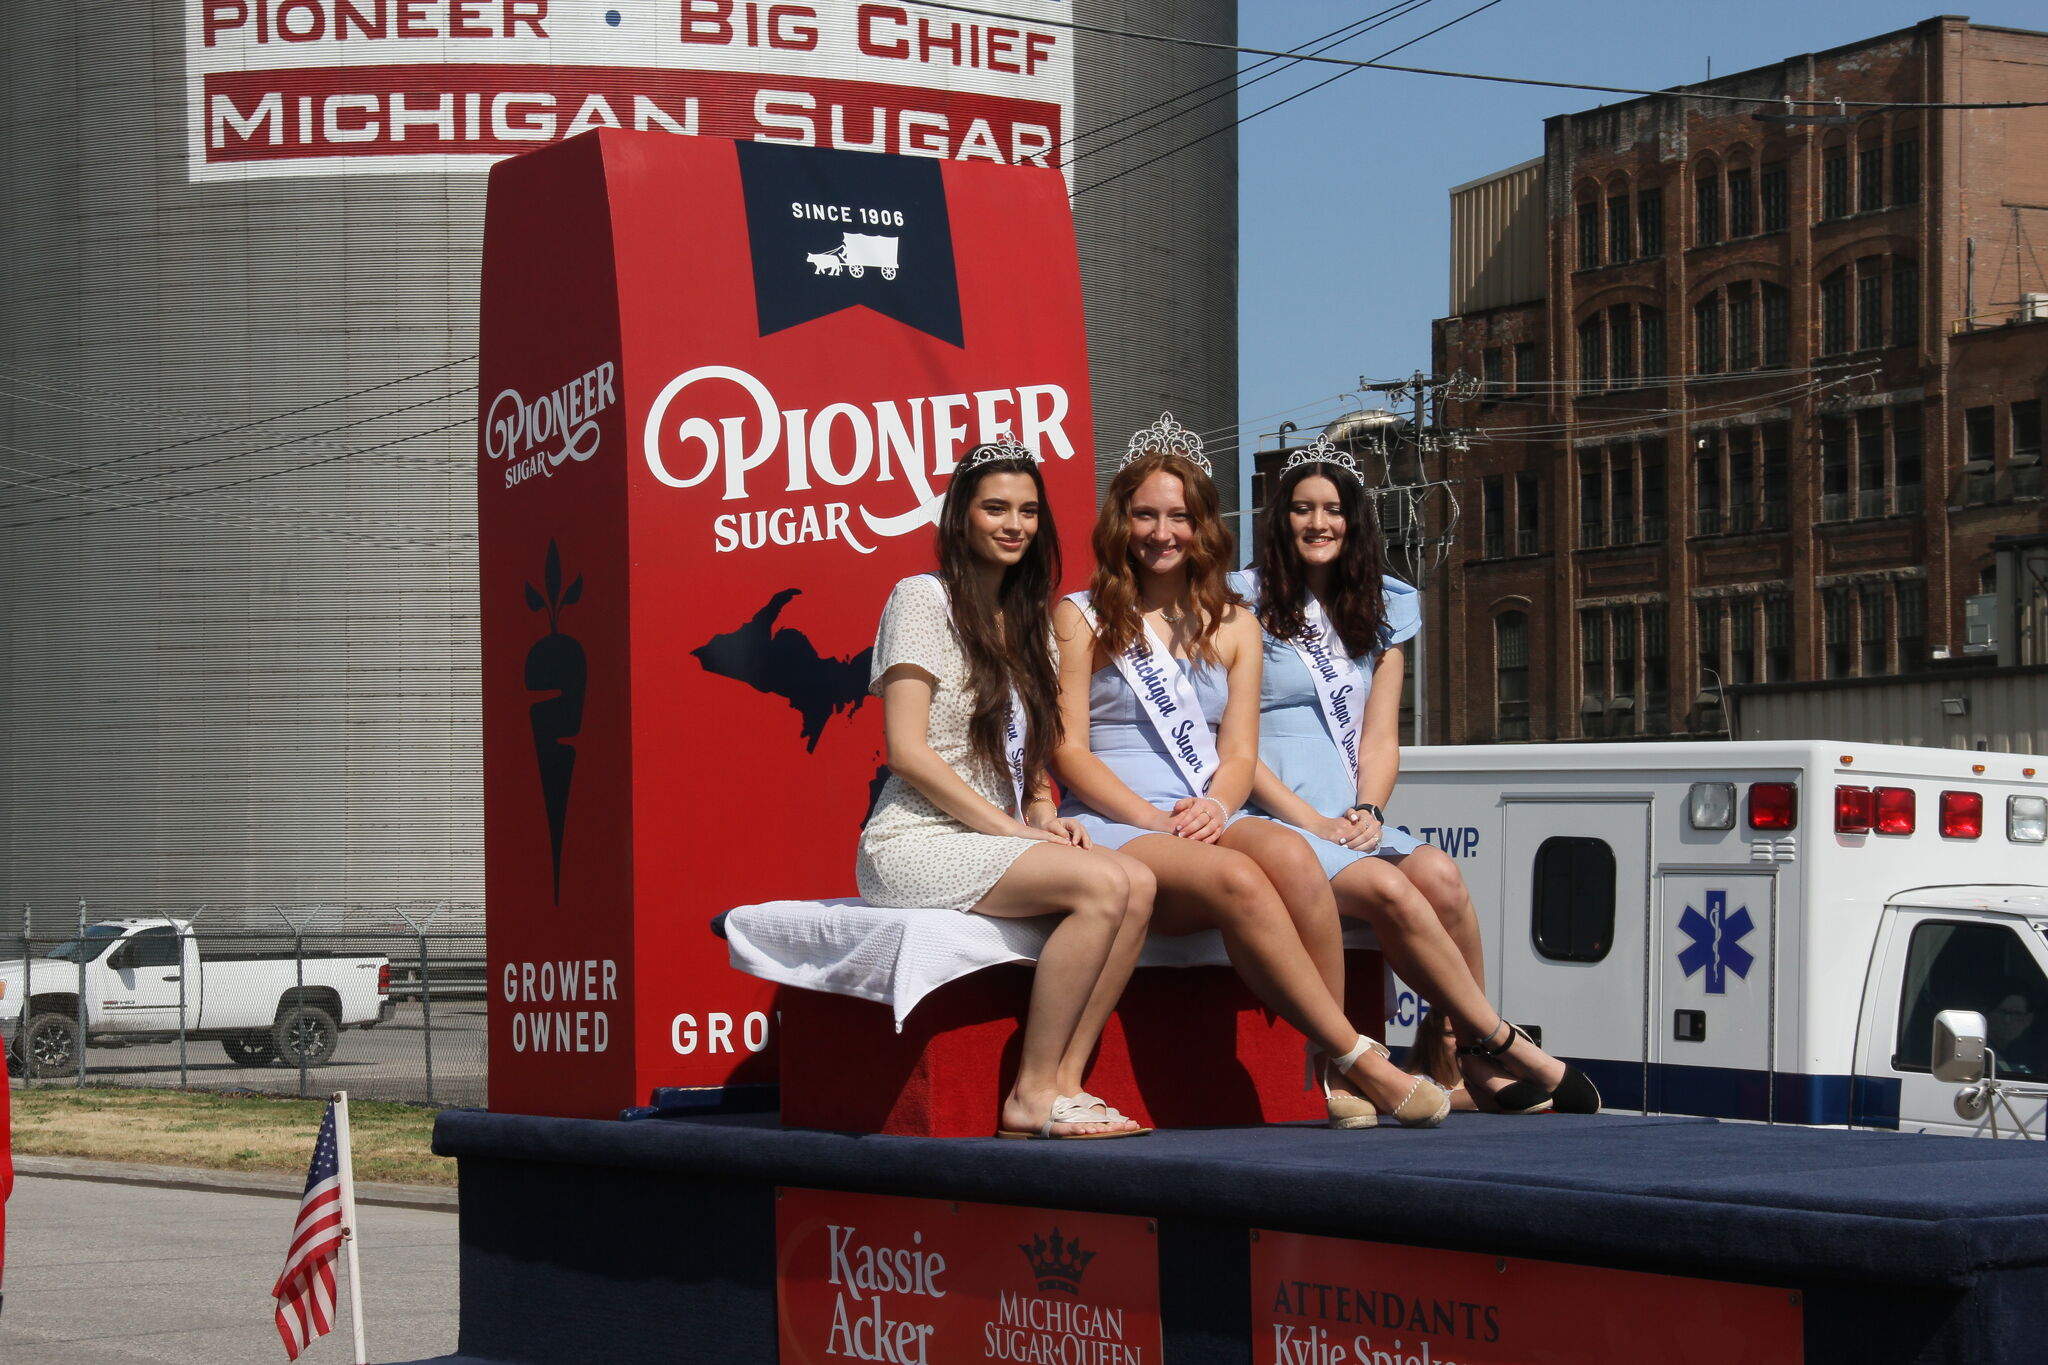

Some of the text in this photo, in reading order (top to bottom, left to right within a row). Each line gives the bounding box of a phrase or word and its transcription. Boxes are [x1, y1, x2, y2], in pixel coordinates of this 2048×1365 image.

[203, 0, 1056, 75] PIONEER BIG CHIEF
[211, 89, 1052, 168] MICHIGAN SUGAR
[792, 202, 904, 227] SINCE 1906
[485, 361, 616, 466] PIONEER
[505, 451, 554, 489] SUGAR
[644, 366, 1075, 536] PIONEER
[714, 502, 878, 554] SUGAR
[1330, 685, 1353, 729] Sugar
[1171, 719, 1204, 774] Sugar
[503, 959, 617, 1002] GROWER
[512, 1011, 609, 1052] OWNED
[671, 1010, 782, 1055] GRO
[826, 1225, 946, 1300] Kassie
[825, 1291, 934, 1365] Acker
[998, 1289, 1123, 1340] MICHIGAN
[1272, 1279, 1501, 1343] ATTENDANTS
